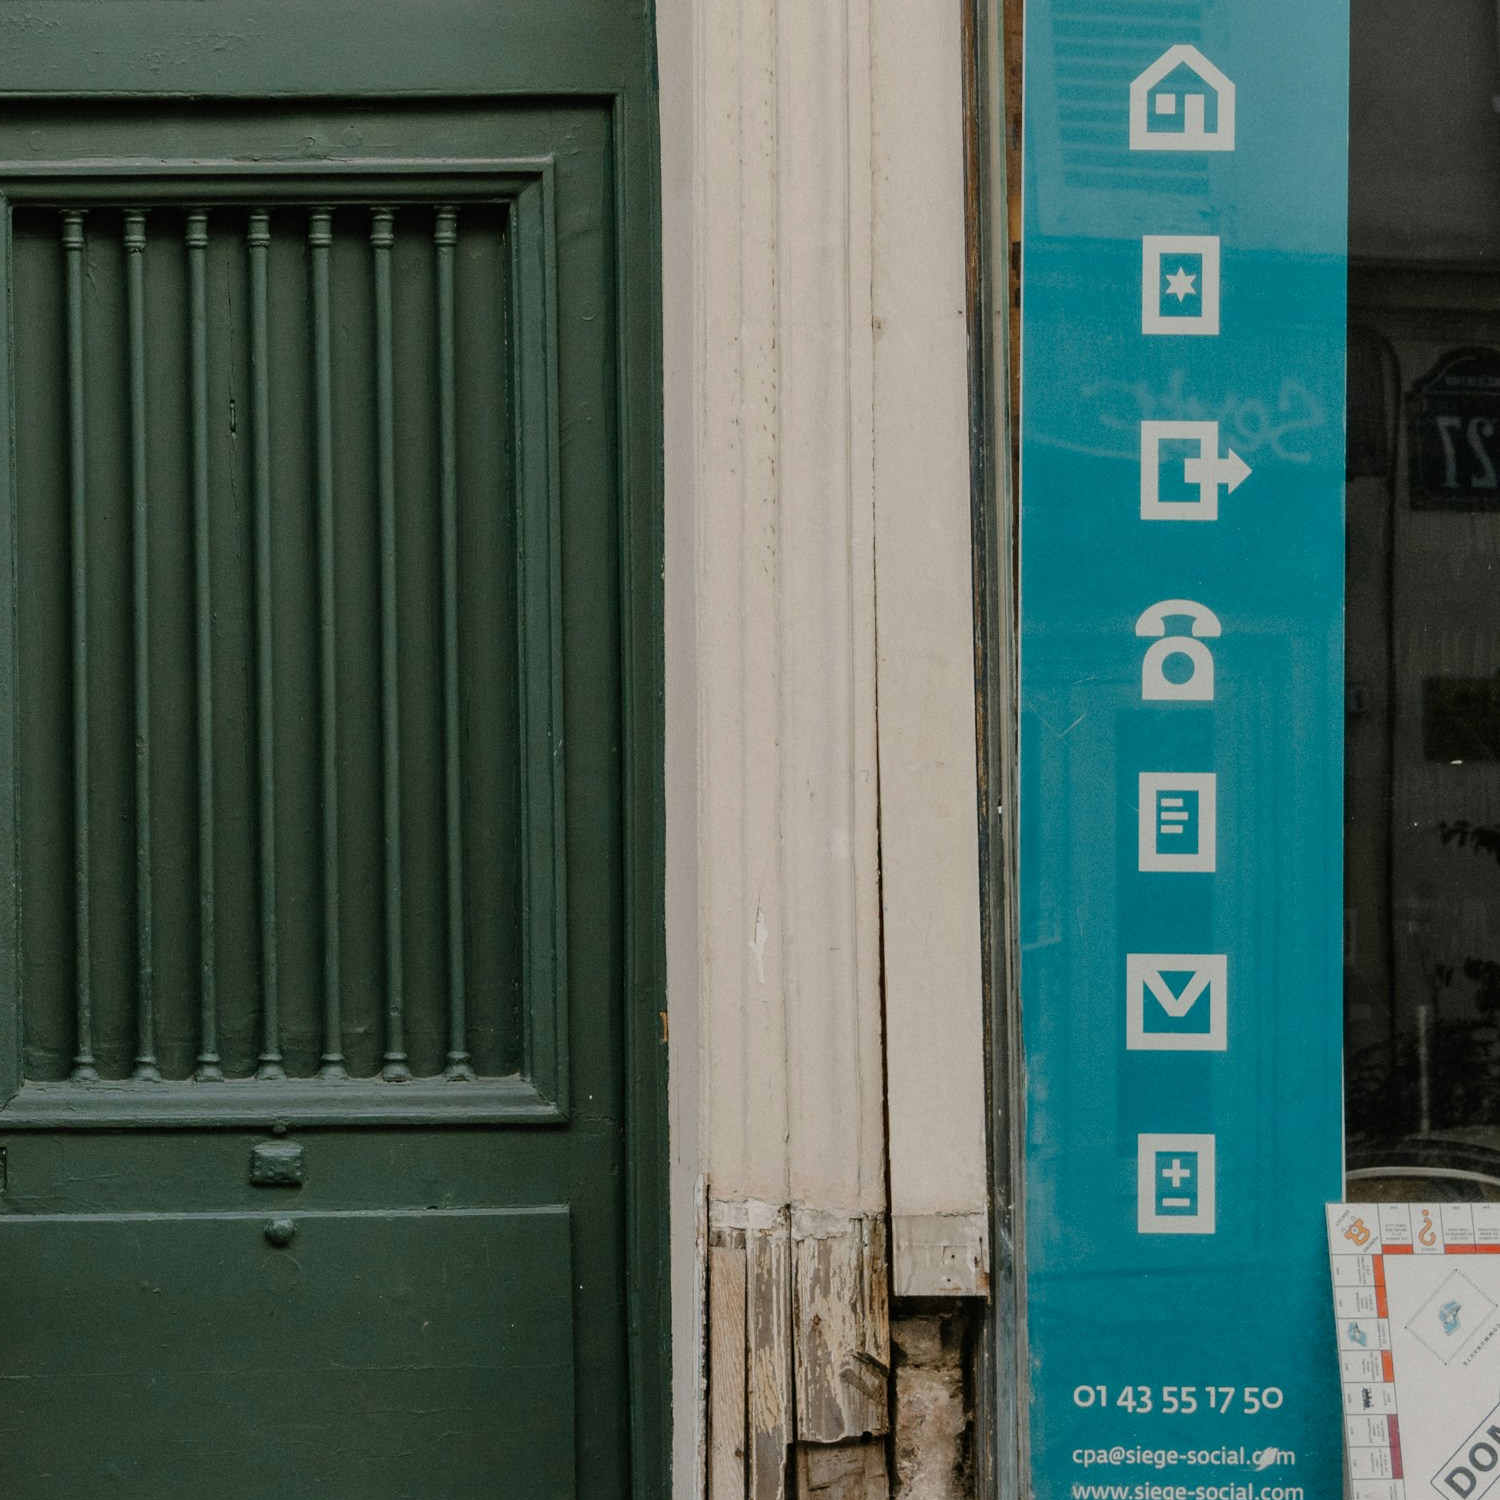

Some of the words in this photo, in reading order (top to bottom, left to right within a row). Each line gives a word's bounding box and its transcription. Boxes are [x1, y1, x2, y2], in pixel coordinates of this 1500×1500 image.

[1073, 1385, 1107, 1407] 01
[1116, 1385, 1153, 1413] 43
[1162, 1386, 1197, 1414] 55
[1205, 1386, 1235, 1414] 17
[1243, 1386, 1283, 1414] 50
[1072, 1445, 1296, 1470] cpa@siege-social.cm
